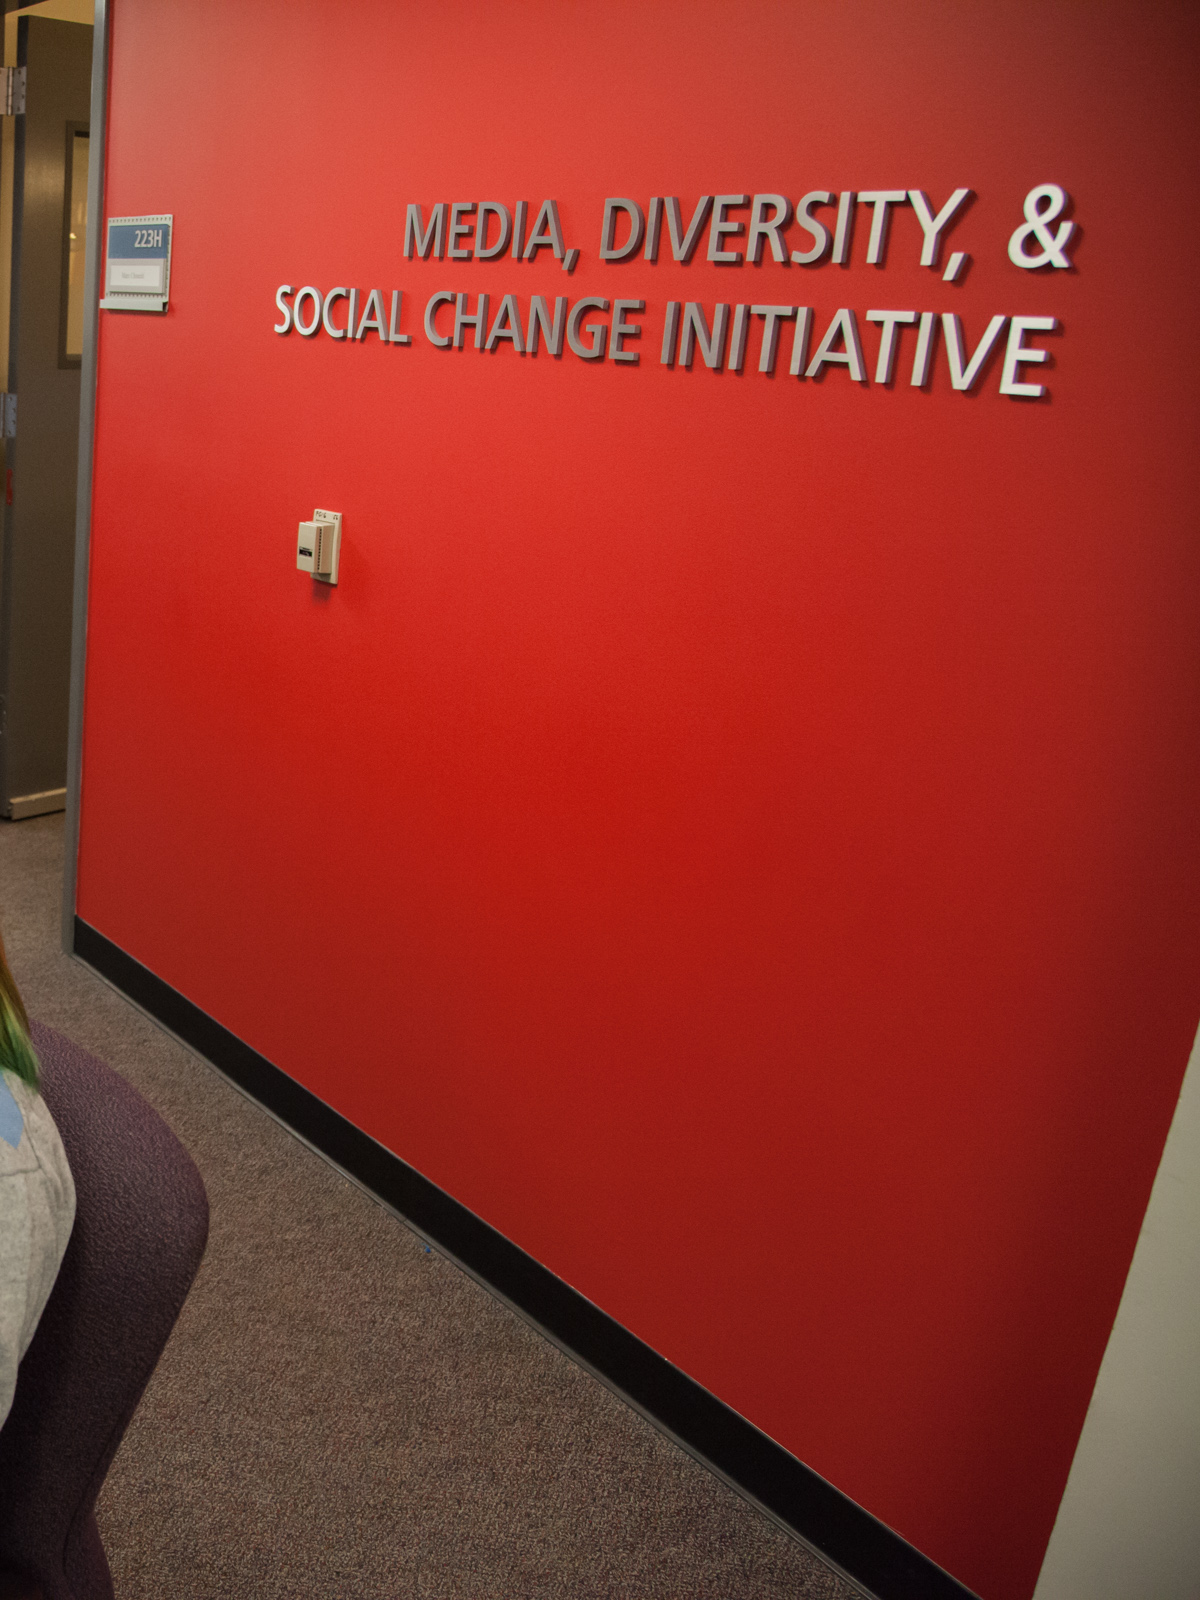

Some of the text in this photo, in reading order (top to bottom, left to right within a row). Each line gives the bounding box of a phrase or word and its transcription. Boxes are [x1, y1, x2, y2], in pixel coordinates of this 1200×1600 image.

[134, 229, 163, 248] 223H
[403, 183, 1077, 283] MEDIA, DIVERSITY, &
[273, 284, 1059, 398] SOCIAL CHANGE INITIATIVE
